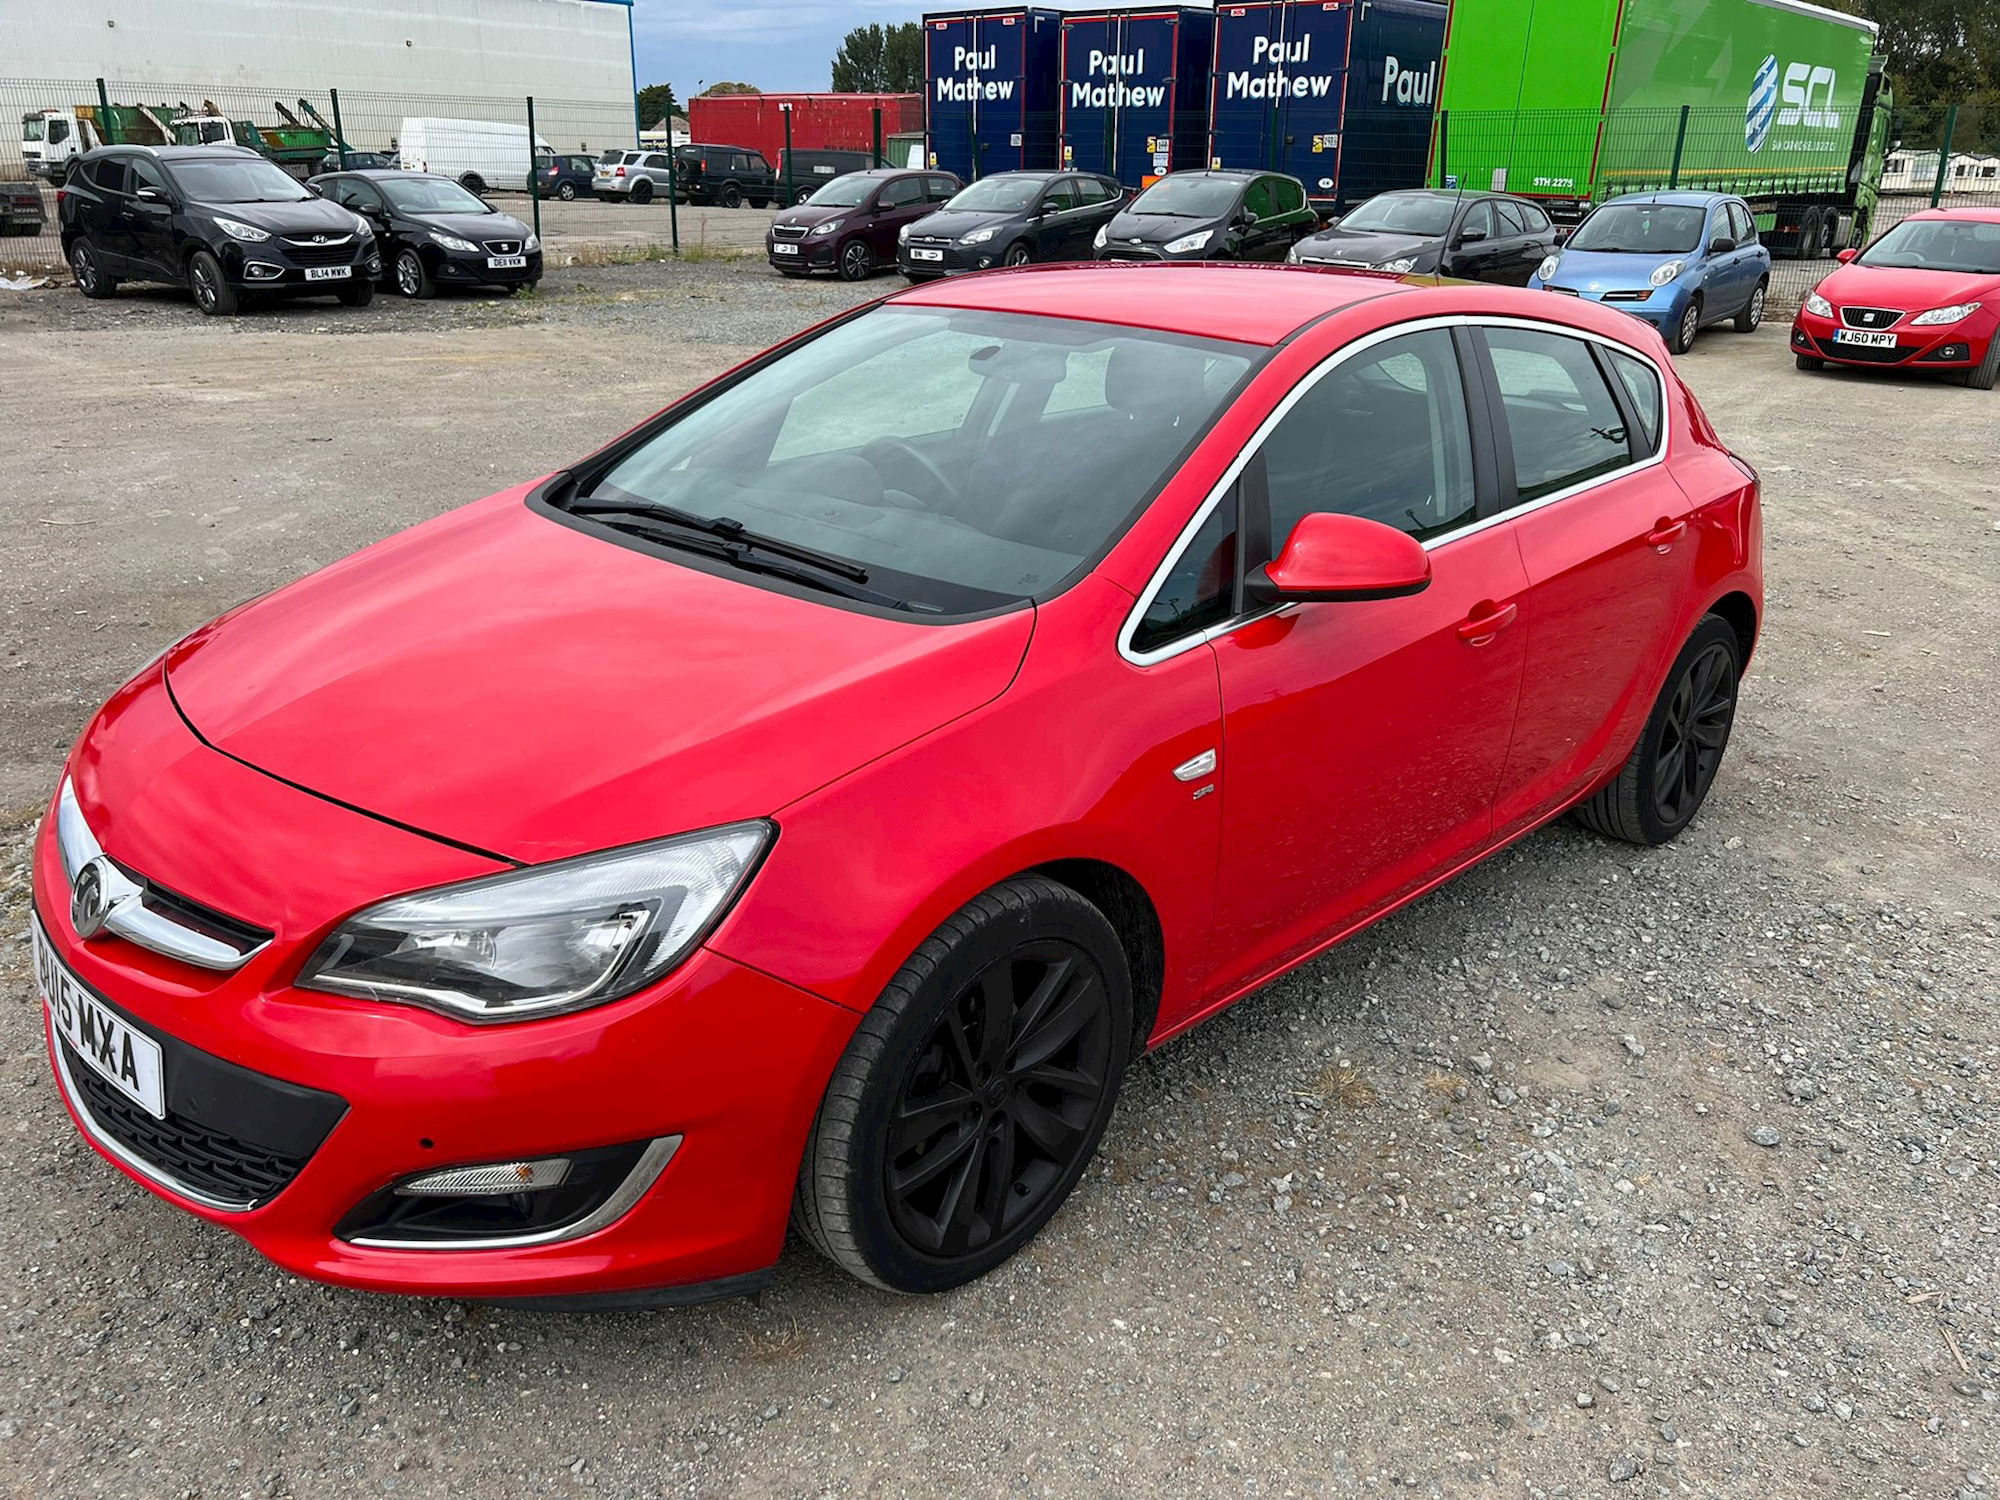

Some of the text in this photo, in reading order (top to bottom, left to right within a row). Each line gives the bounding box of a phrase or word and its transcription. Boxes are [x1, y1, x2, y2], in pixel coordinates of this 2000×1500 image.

[954, 44, 996, 71] Paul
[1089, 48, 1144, 76] Paul
[1253, 33, 1311, 65] Paul
[937, 76, 1014, 102] Mathew
[1226, 69, 1333, 100] Mathew
[1382, 55, 1437, 106] Paul
[1072, 81, 1165, 108] Mathew
[1777, 62, 1840, 128] SCL
[1533, 177, 1573, 188] STH 2275
[311, 268, 329, 279] BL14
[1840, 331, 1895, 346] WJ60 MPY
[78, 993, 140, 1093] MXA
